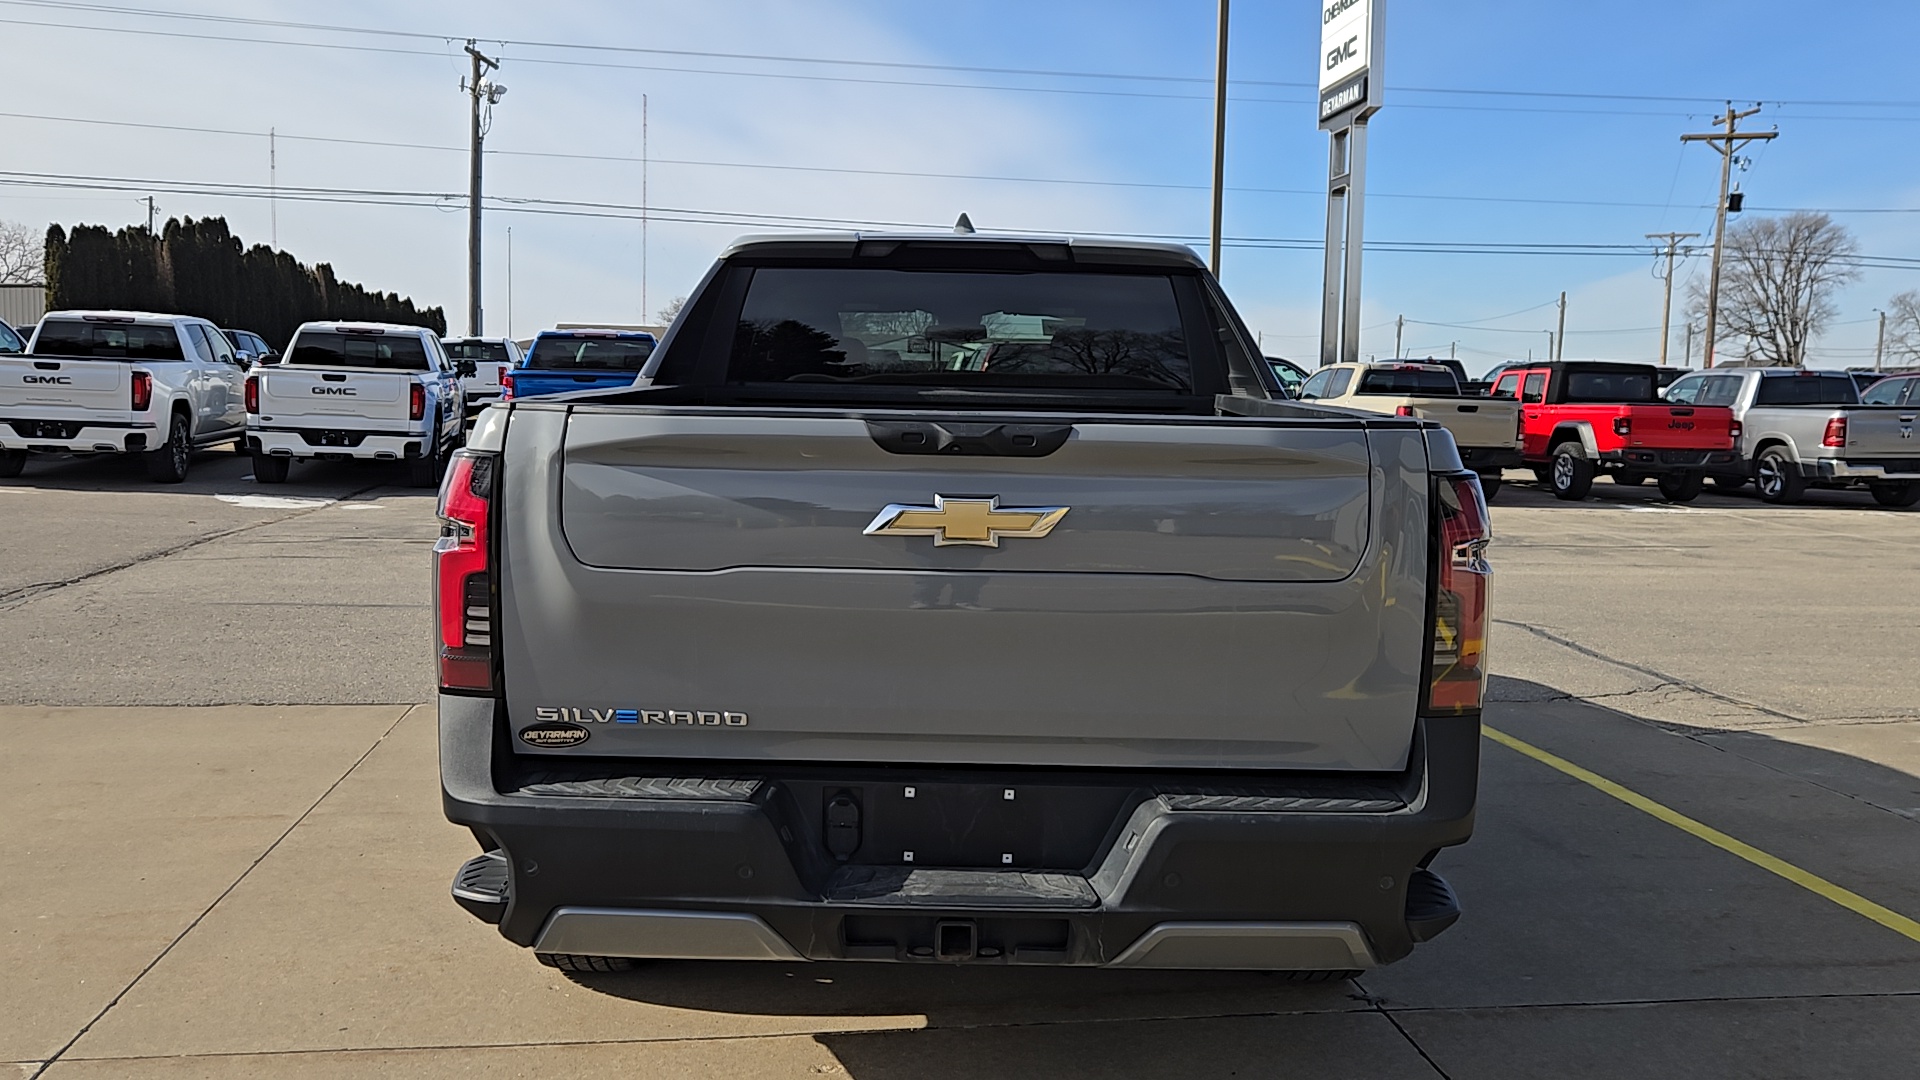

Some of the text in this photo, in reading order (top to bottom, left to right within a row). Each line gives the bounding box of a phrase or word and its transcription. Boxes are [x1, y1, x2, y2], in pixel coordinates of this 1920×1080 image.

[1326, 34, 1358, 71] GMC
[1322, 83, 1360, 117] DEYARMAN
[22, 375, 72, 385] GMC
[311, 386, 358, 396] GMC
[1667, 419, 1695, 431] Jeep
[535, 706, 749, 727] SILVERADO
[523, 730, 586, 739] DEYARMAN
